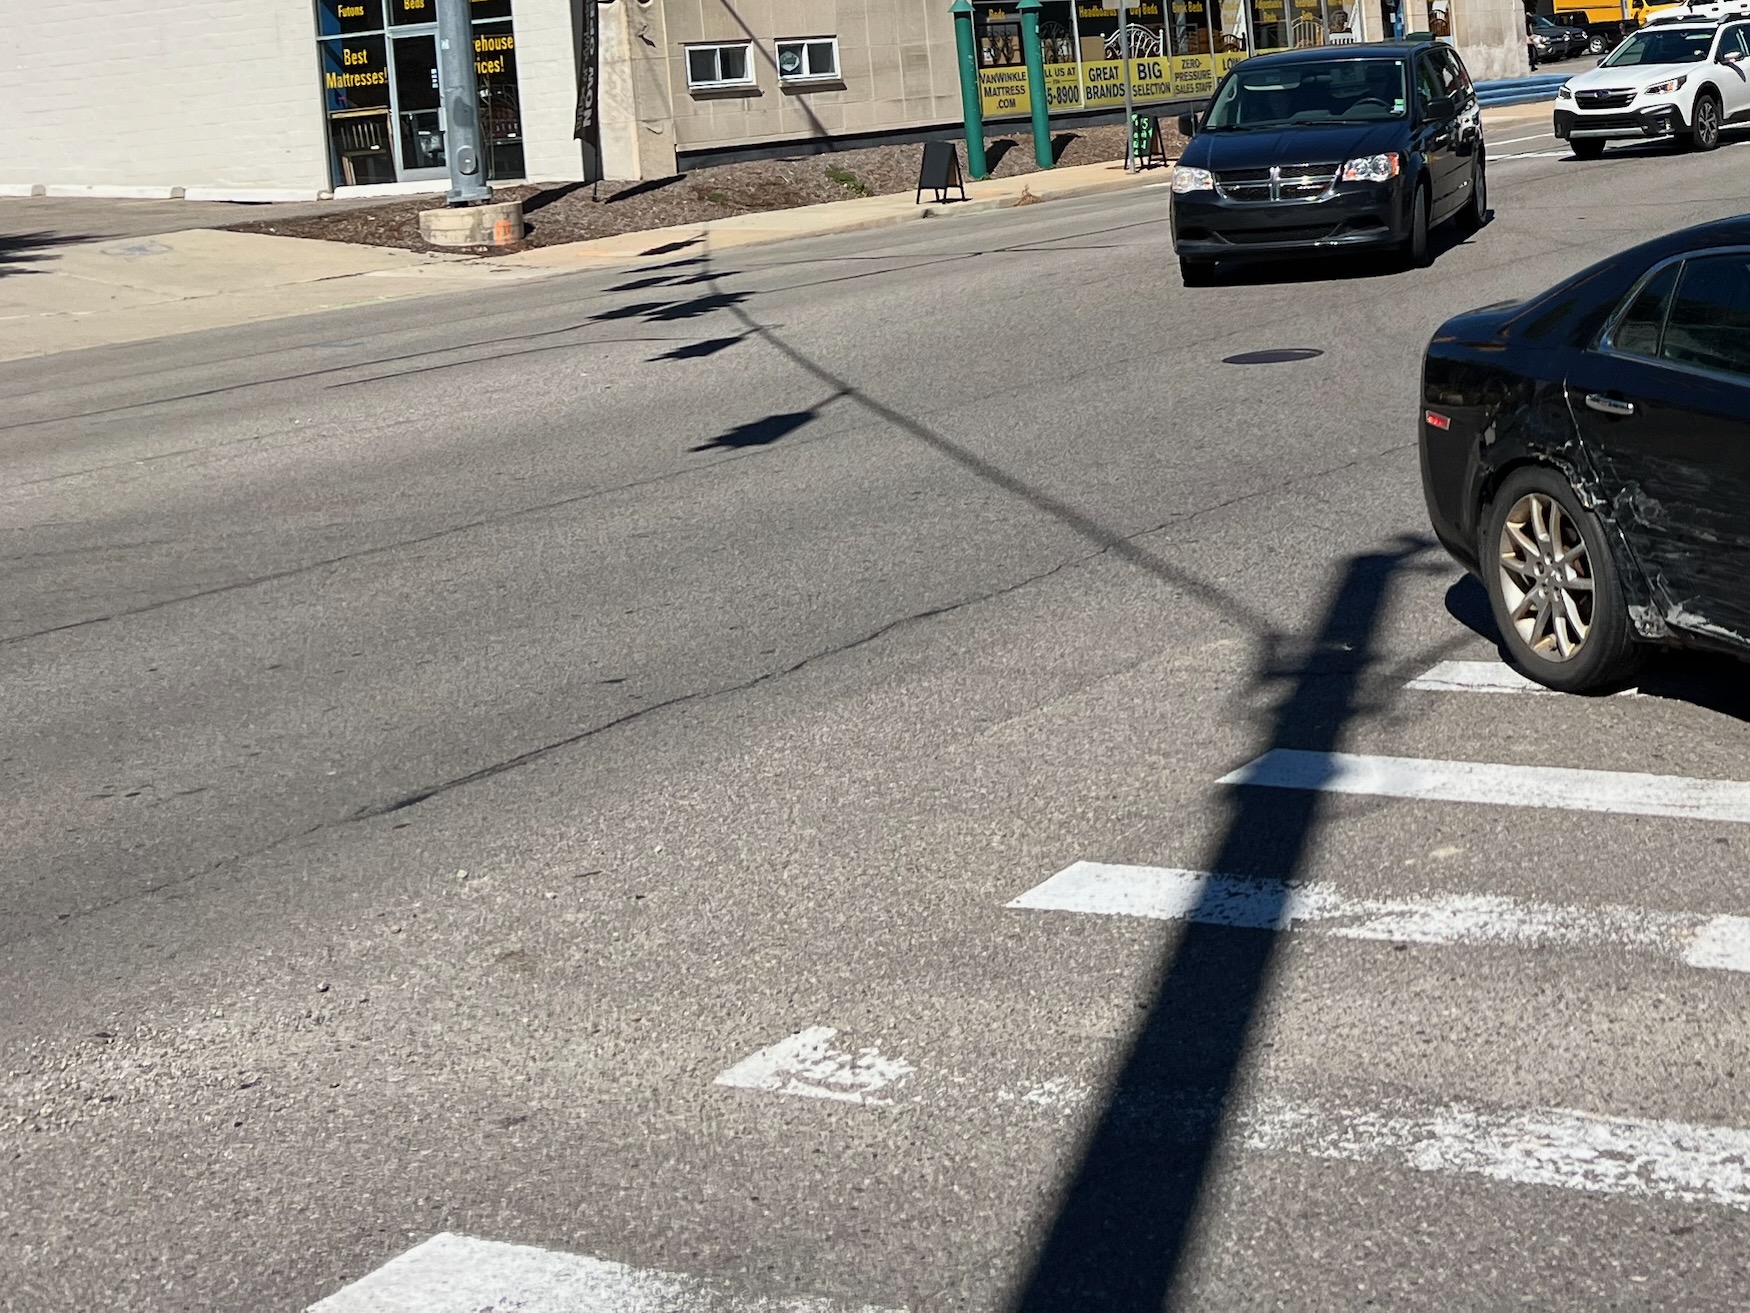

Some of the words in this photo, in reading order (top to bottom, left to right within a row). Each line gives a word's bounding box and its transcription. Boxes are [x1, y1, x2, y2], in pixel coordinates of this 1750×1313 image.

[338, 4, 365, 18] Futons
[343, 48, 368, 65] Best
[326, 66, 389, 89] Mattresses!
[1054, 67, 1065, 77] US
[1067, 67, 1076, 76] AT
[1088, 65, 1119, 82] GREAT
[1136, 61, 1163, 80] BIG
[1174, 69, 1212, 82] PRESSURE
[1085, 83, 1126, 100] BRANDS
[1132, 82, 1171, 97] SELECTION
[1175, 83, 1195, 95] SALES
[1195, 81, 1212, 93] STAFF
[996, 98, 1016, 109] .COM
